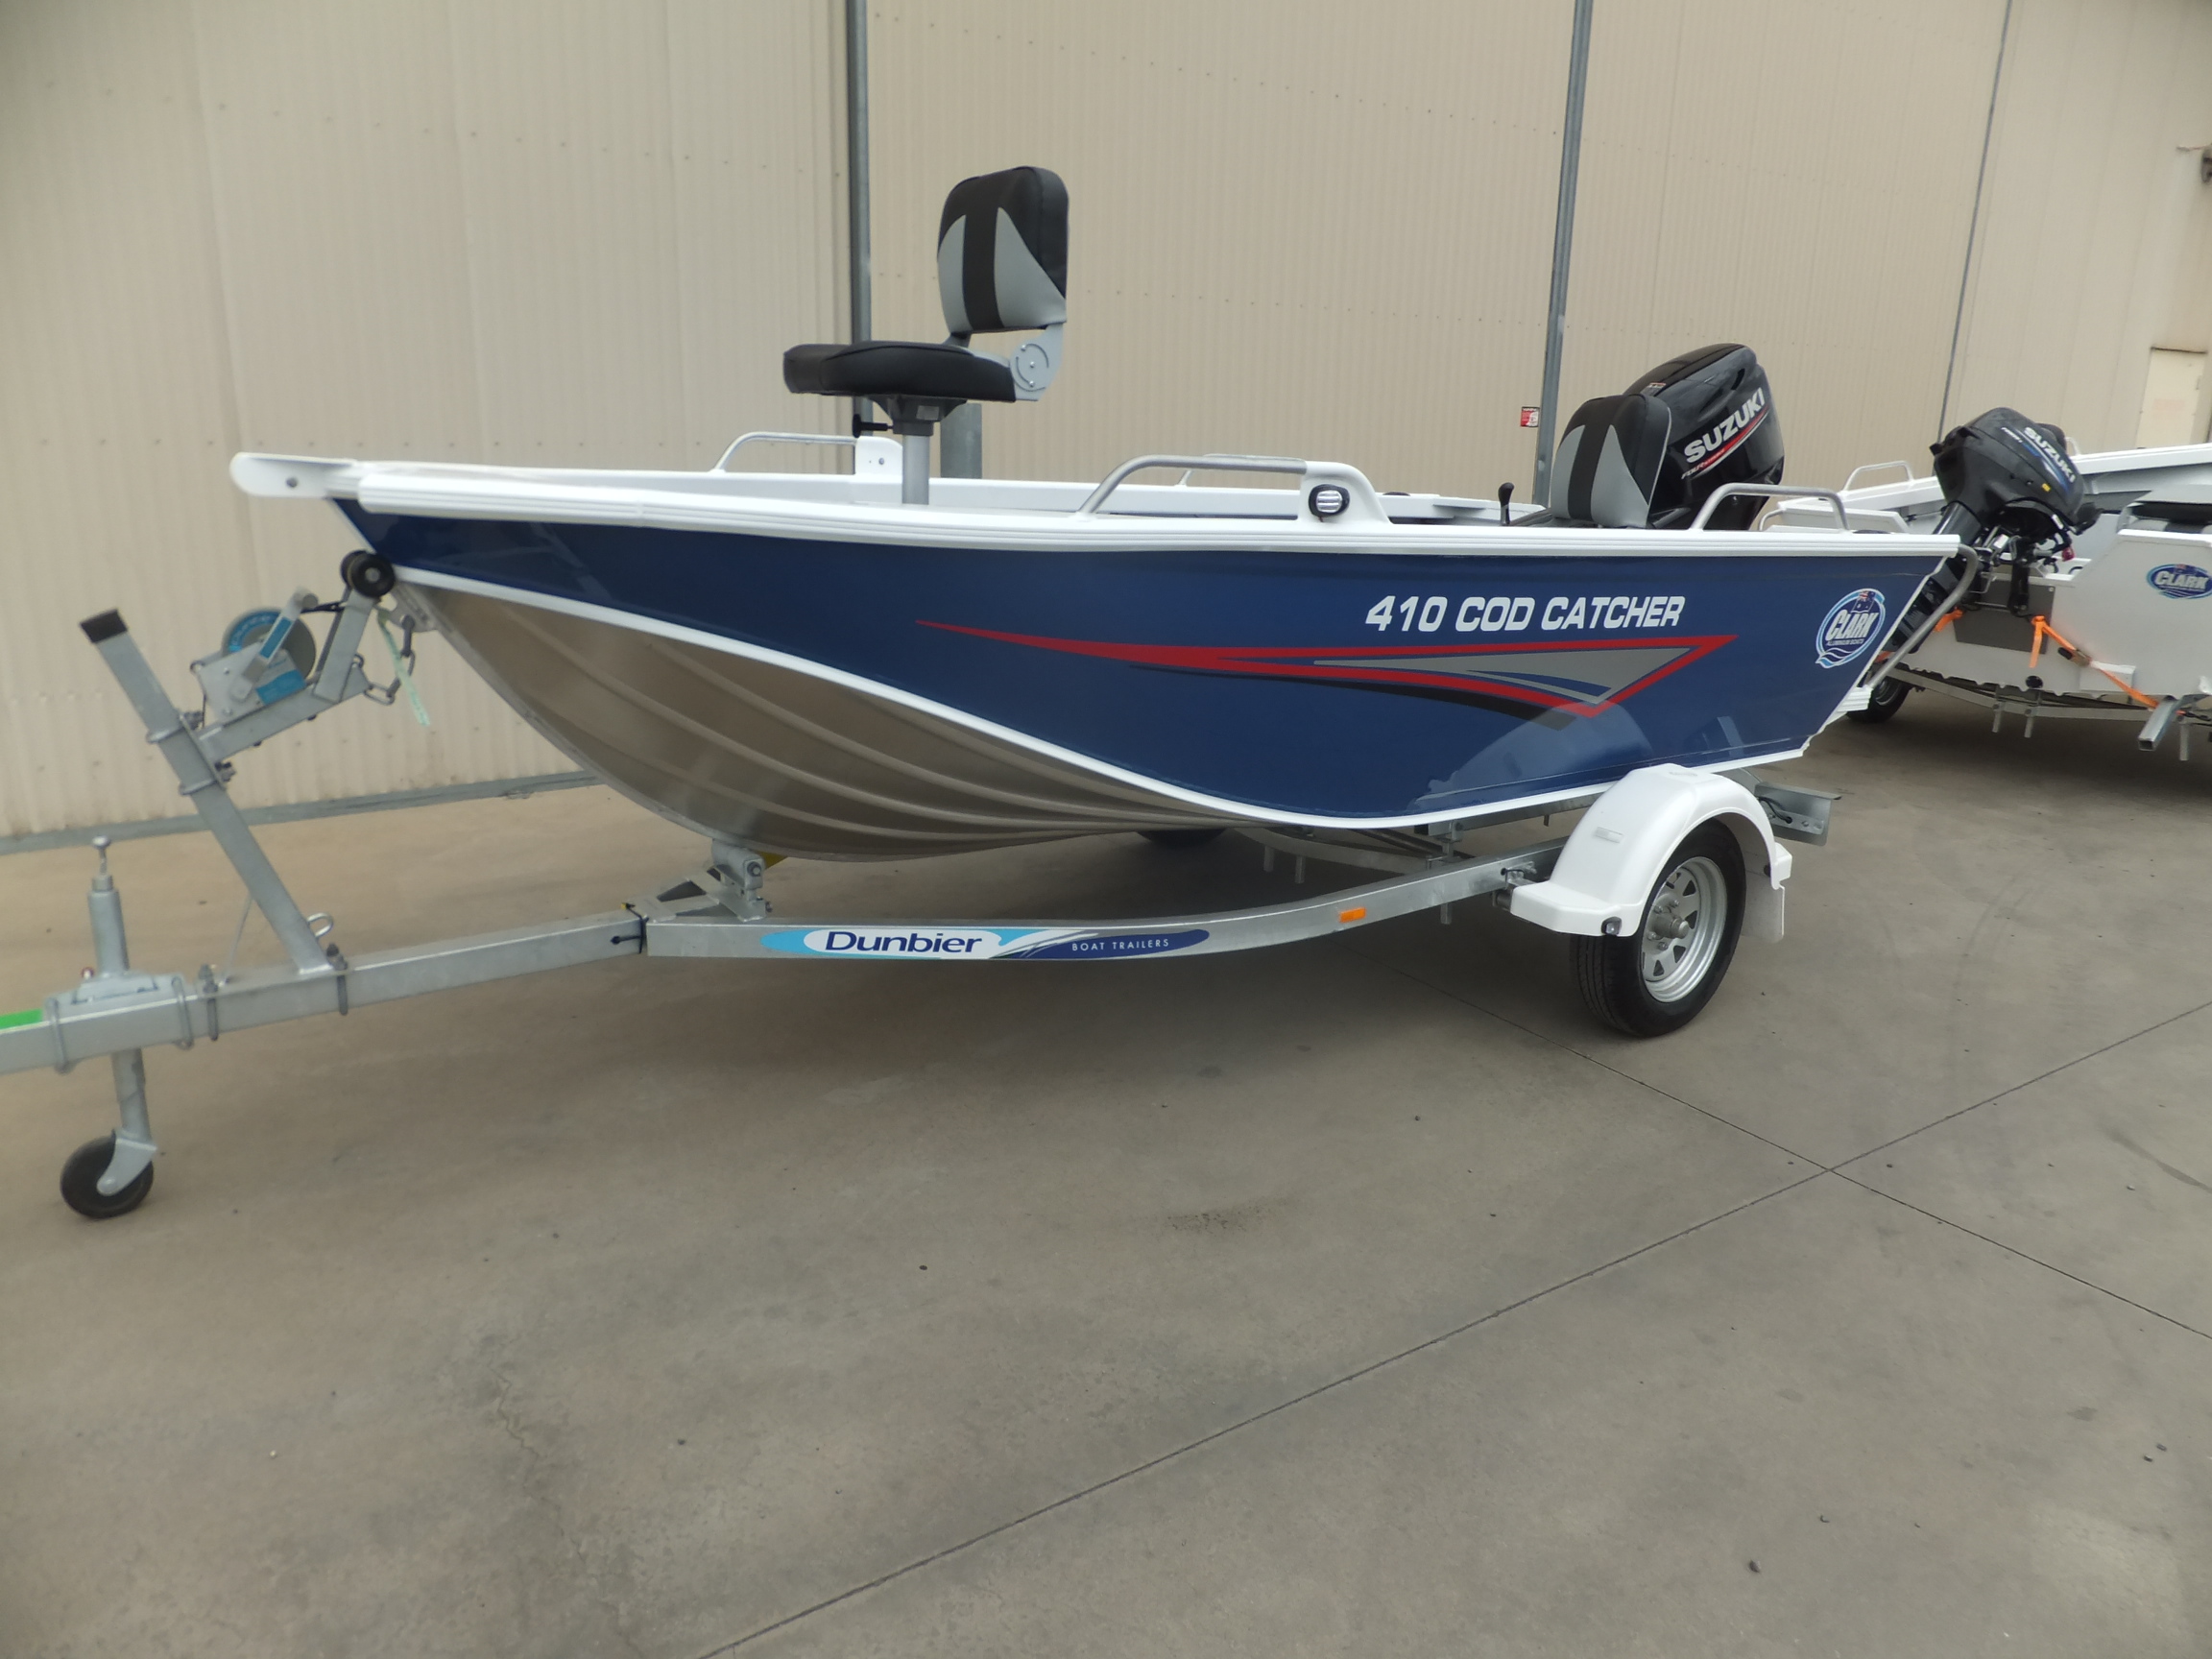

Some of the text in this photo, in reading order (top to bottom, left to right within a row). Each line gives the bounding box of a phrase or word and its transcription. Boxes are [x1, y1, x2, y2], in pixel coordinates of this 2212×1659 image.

[1684, 387, 1766, 463] SUZUKI
[2024, 426, 2076, 483] SUZUKI
[2154, 570, 2210, 589] CLARK
[1365, 595, 1686, 632] 410 COD CATCHER
[1825, 609, 1880, 641] CLARK
[825, 930, 983, 953] Dunbier
[1071, 939, 1169, 951] BOAT TRAILERS
